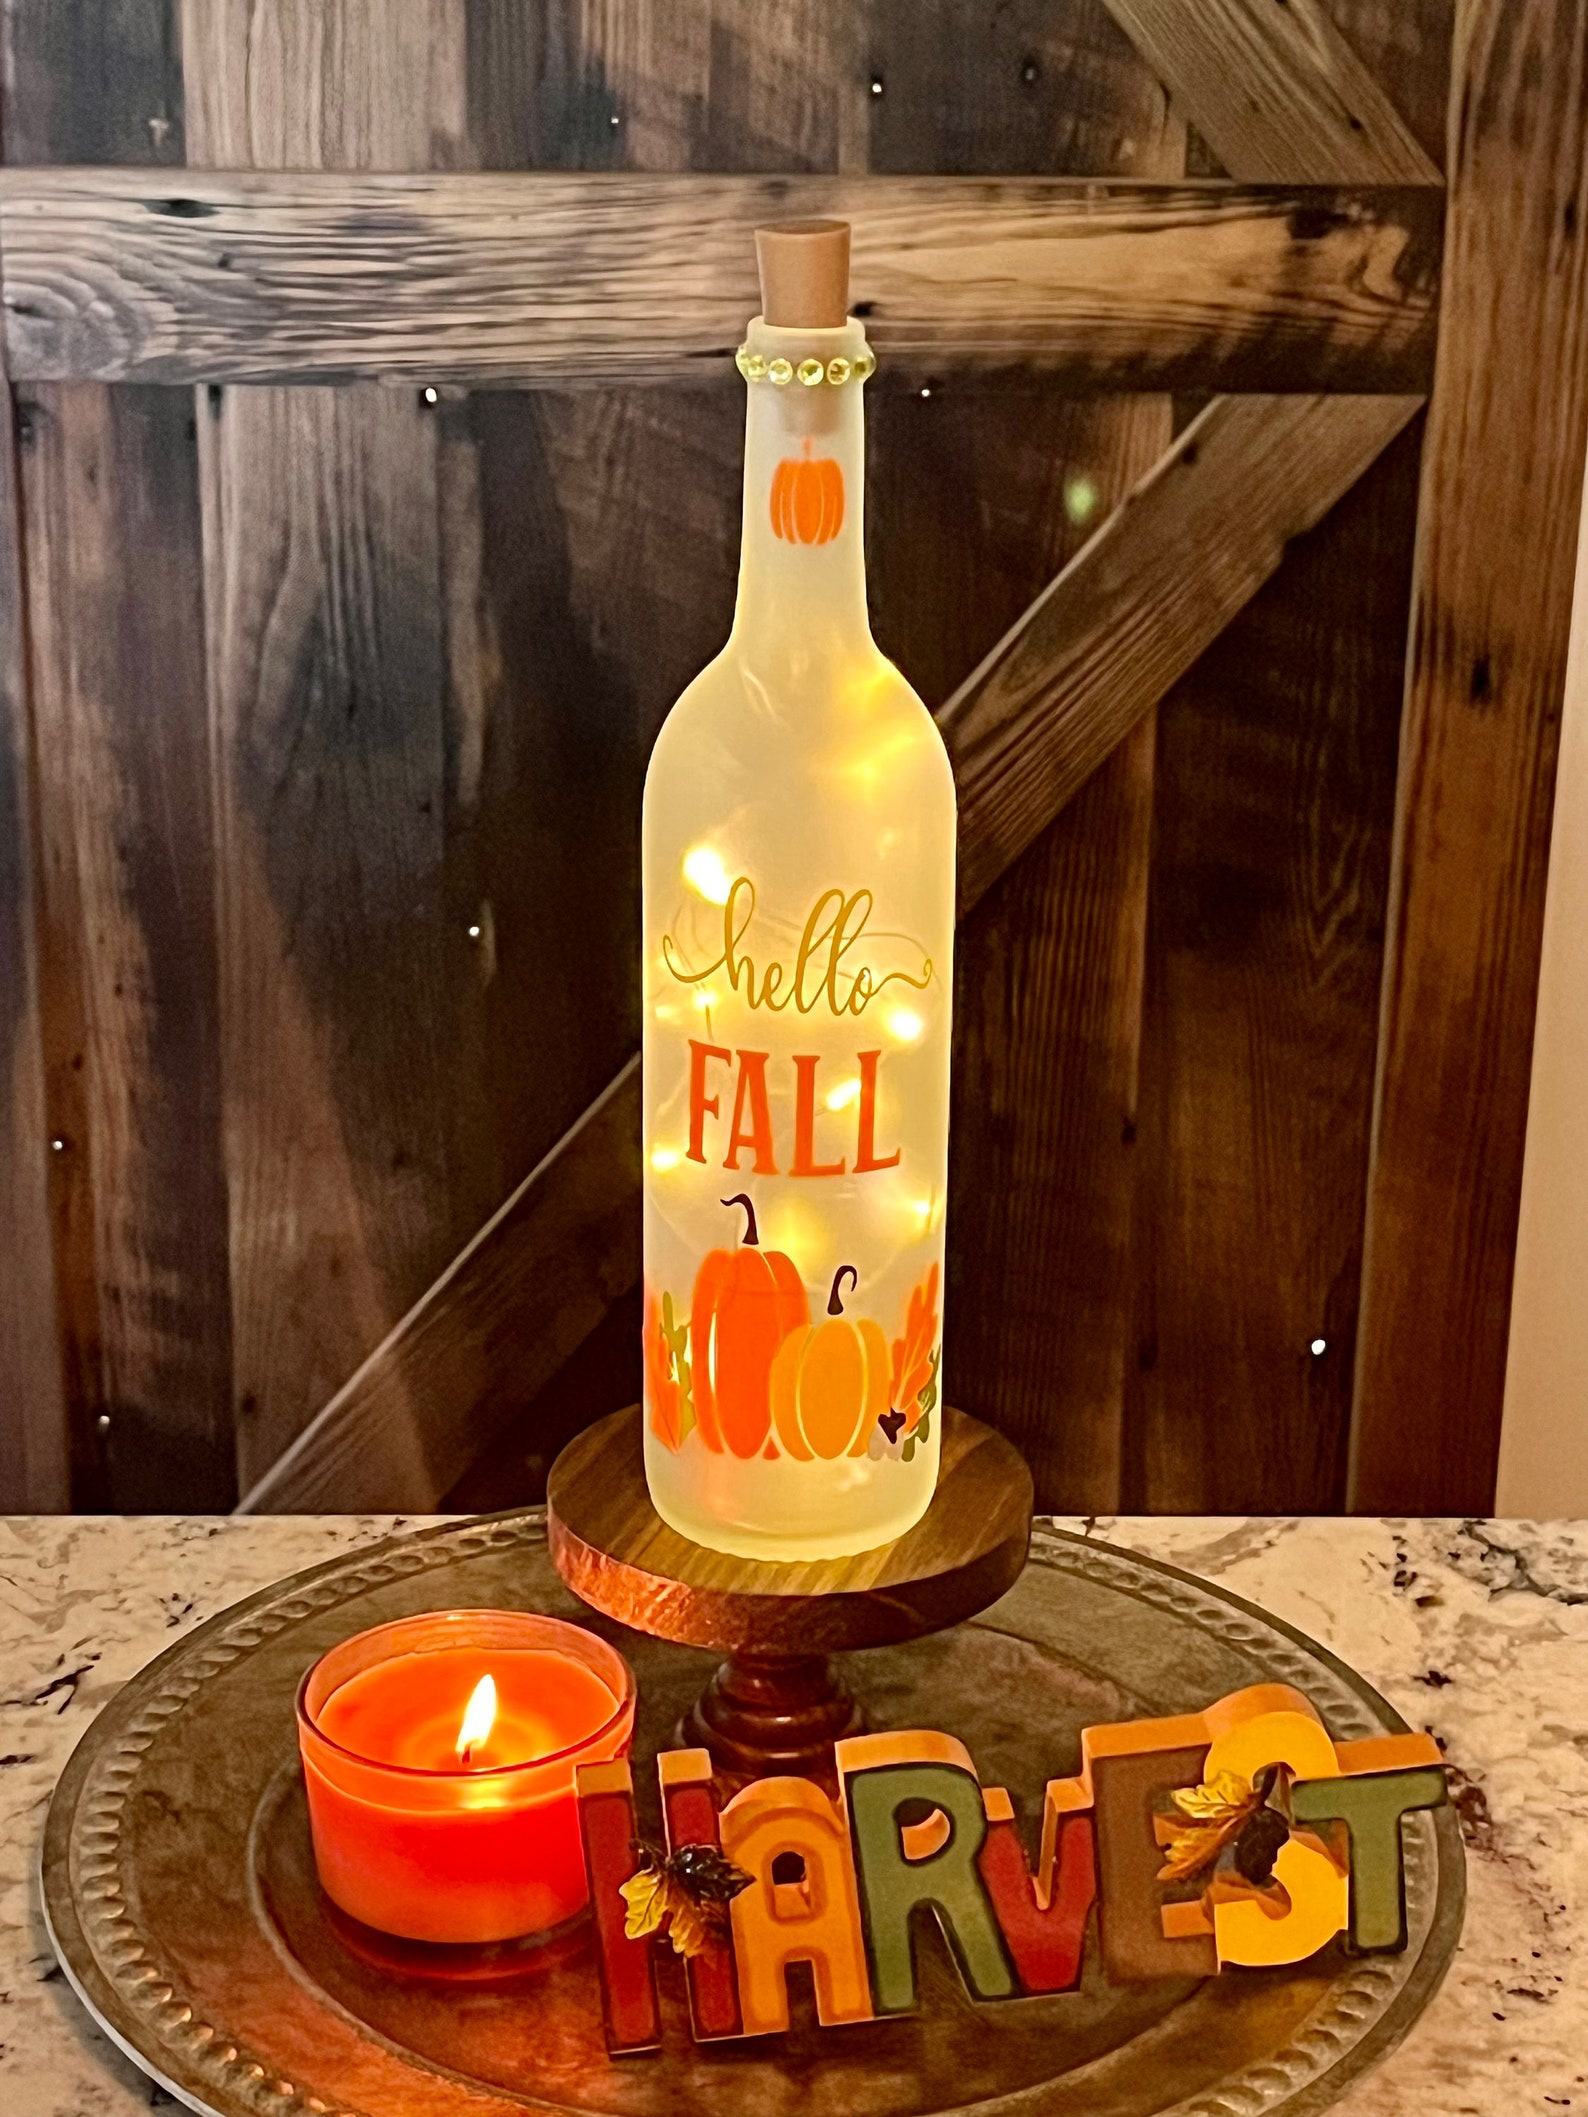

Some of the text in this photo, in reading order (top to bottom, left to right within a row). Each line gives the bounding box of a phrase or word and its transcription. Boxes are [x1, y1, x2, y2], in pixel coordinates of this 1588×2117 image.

[662, 876, 933, 1016] hello
[685, 1038, 902, 1178] FALL
[575, 1684, 1449, 2057] HARVEST
